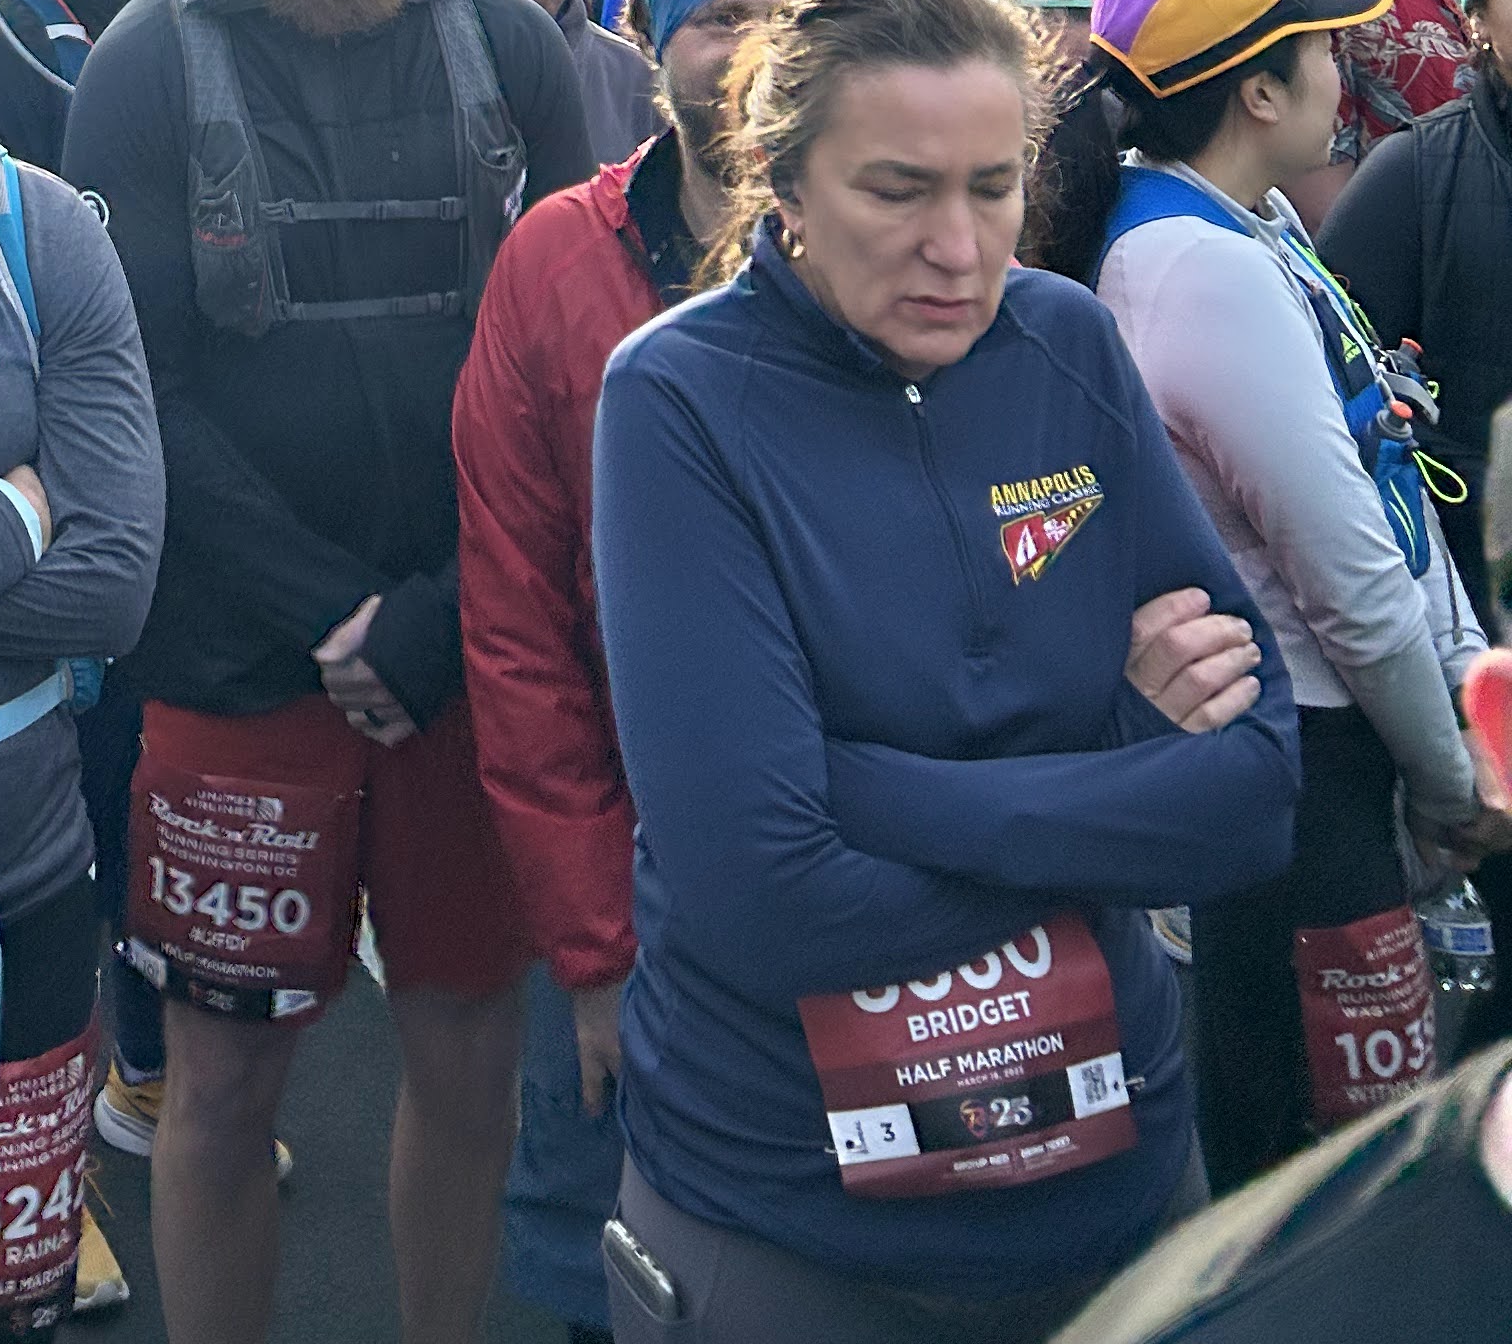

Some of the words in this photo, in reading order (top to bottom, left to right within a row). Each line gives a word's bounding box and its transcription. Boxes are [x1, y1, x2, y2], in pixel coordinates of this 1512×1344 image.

[991, 465, 1096, 505] ANNAPOLIS
[992, 497, 1051, 517] RUNNING
[1051, 482, 1102, 505] CLASSIC
[182, 796, 256, 817] AIRLINES
[196, 790, 254, 806] UNITED
[148, 791, 219, 838] Rock
[246, 822, 321, 849] Roll
[155, 823, 229, 856] RUNNING
[233, 848, 298, 864] SERIES
[156, 837, 271, 875] WASHINGTON
[273, 866, 298, 878] DC
[147, 855, 311, 935] 13450
[195, 957, 278, 978] MARATHON
[1319, 963, 1402, 990] Rock
[906, 990, 1031, 1043] BRIDGET
[895, 1058, 952, 1087] HALF
[956, 1033, 1065, 1075] MARATHON
[8, 1068, 65, 1093] UNITED
[957, 1073, 988, 1087] MARCH
[990, 1095, 1034, 1127] 25
[880, 1122, 896, 1142] 3
[4, 1229, 71, 1266] RAINA
